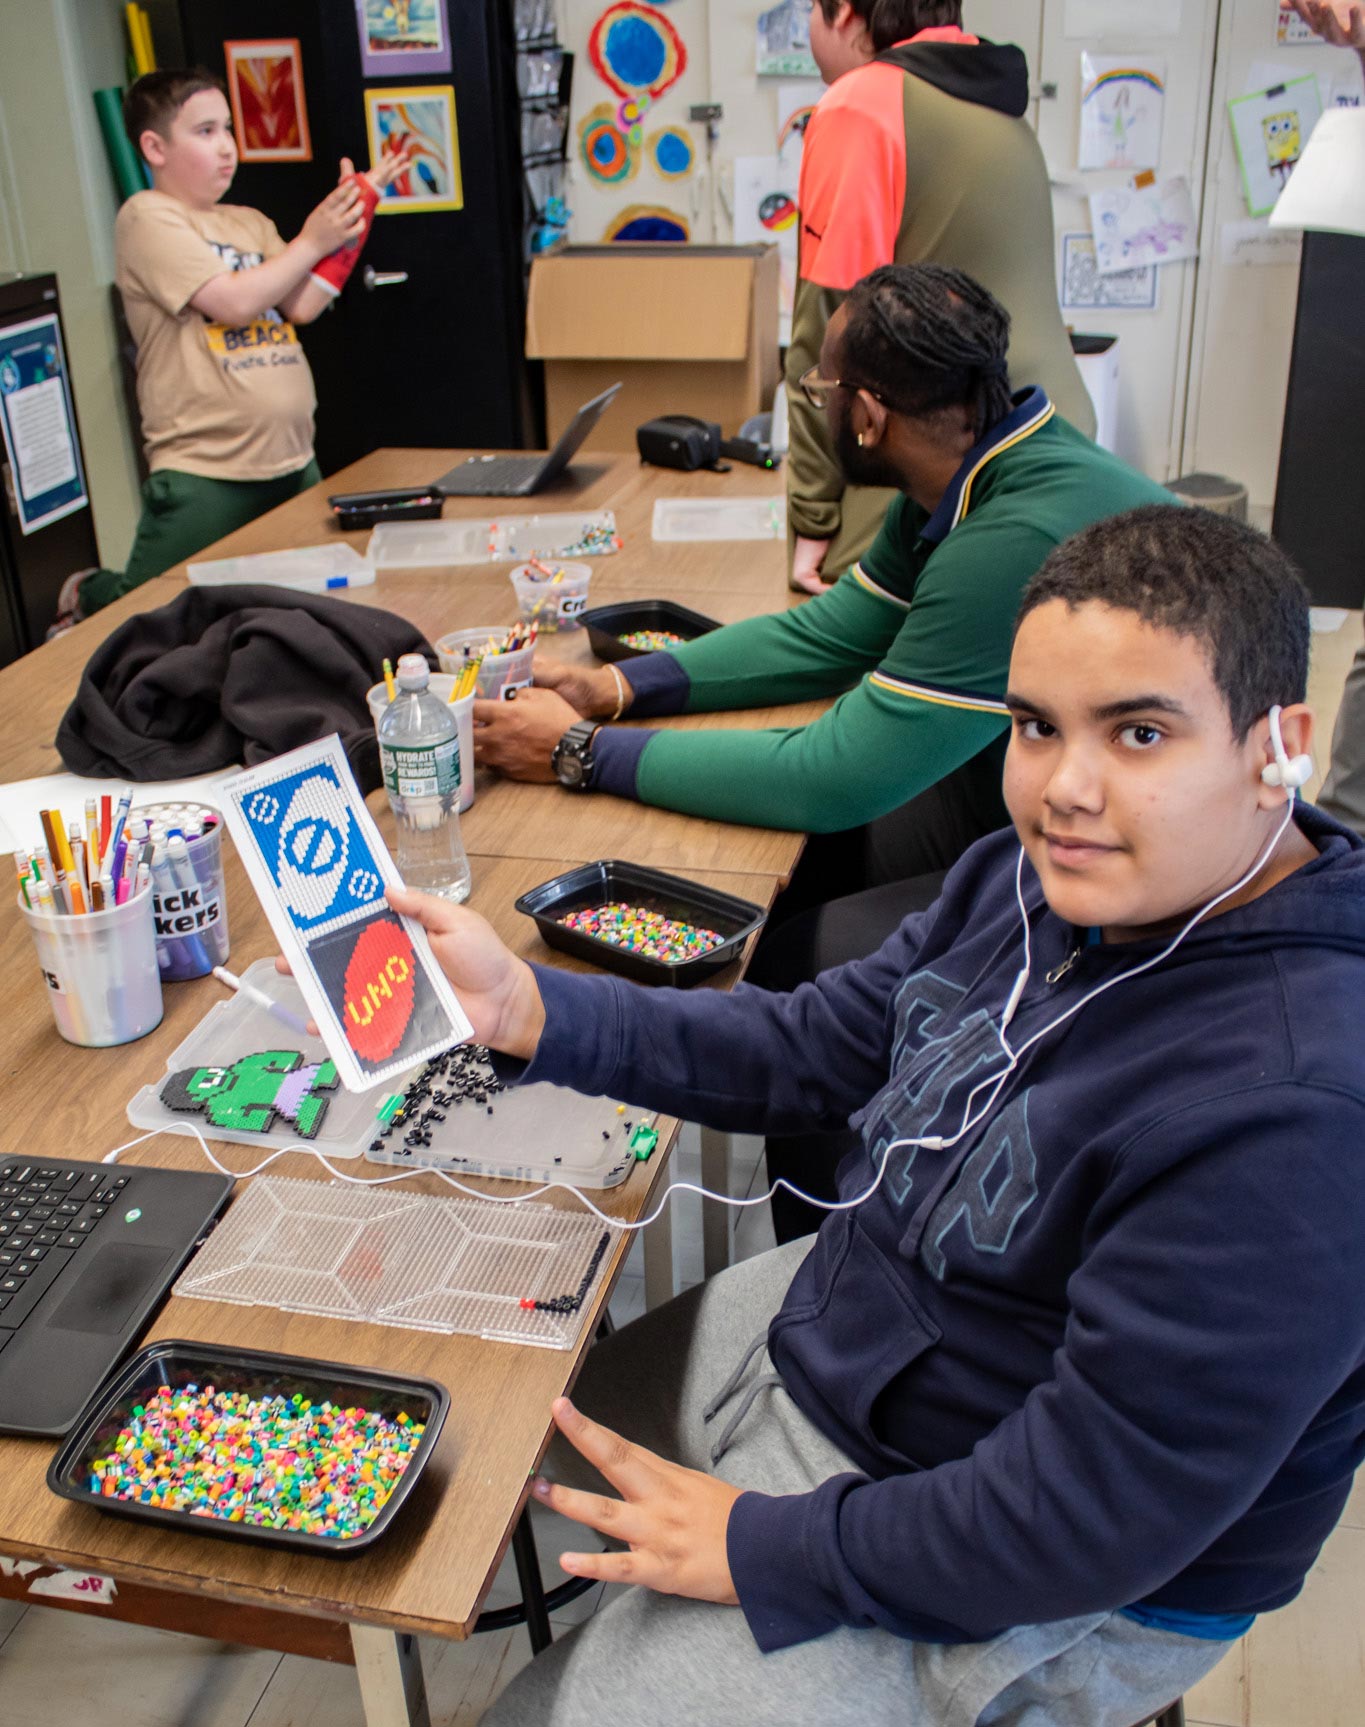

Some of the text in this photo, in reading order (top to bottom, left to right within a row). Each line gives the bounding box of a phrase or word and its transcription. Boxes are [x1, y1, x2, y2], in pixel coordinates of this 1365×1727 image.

[396, 751, 435, 762] HYDRATE
[153, 889, 200, 914] ick
[154, 901, 218, 935] kers
[347, 955, 410, 1027] UNO
